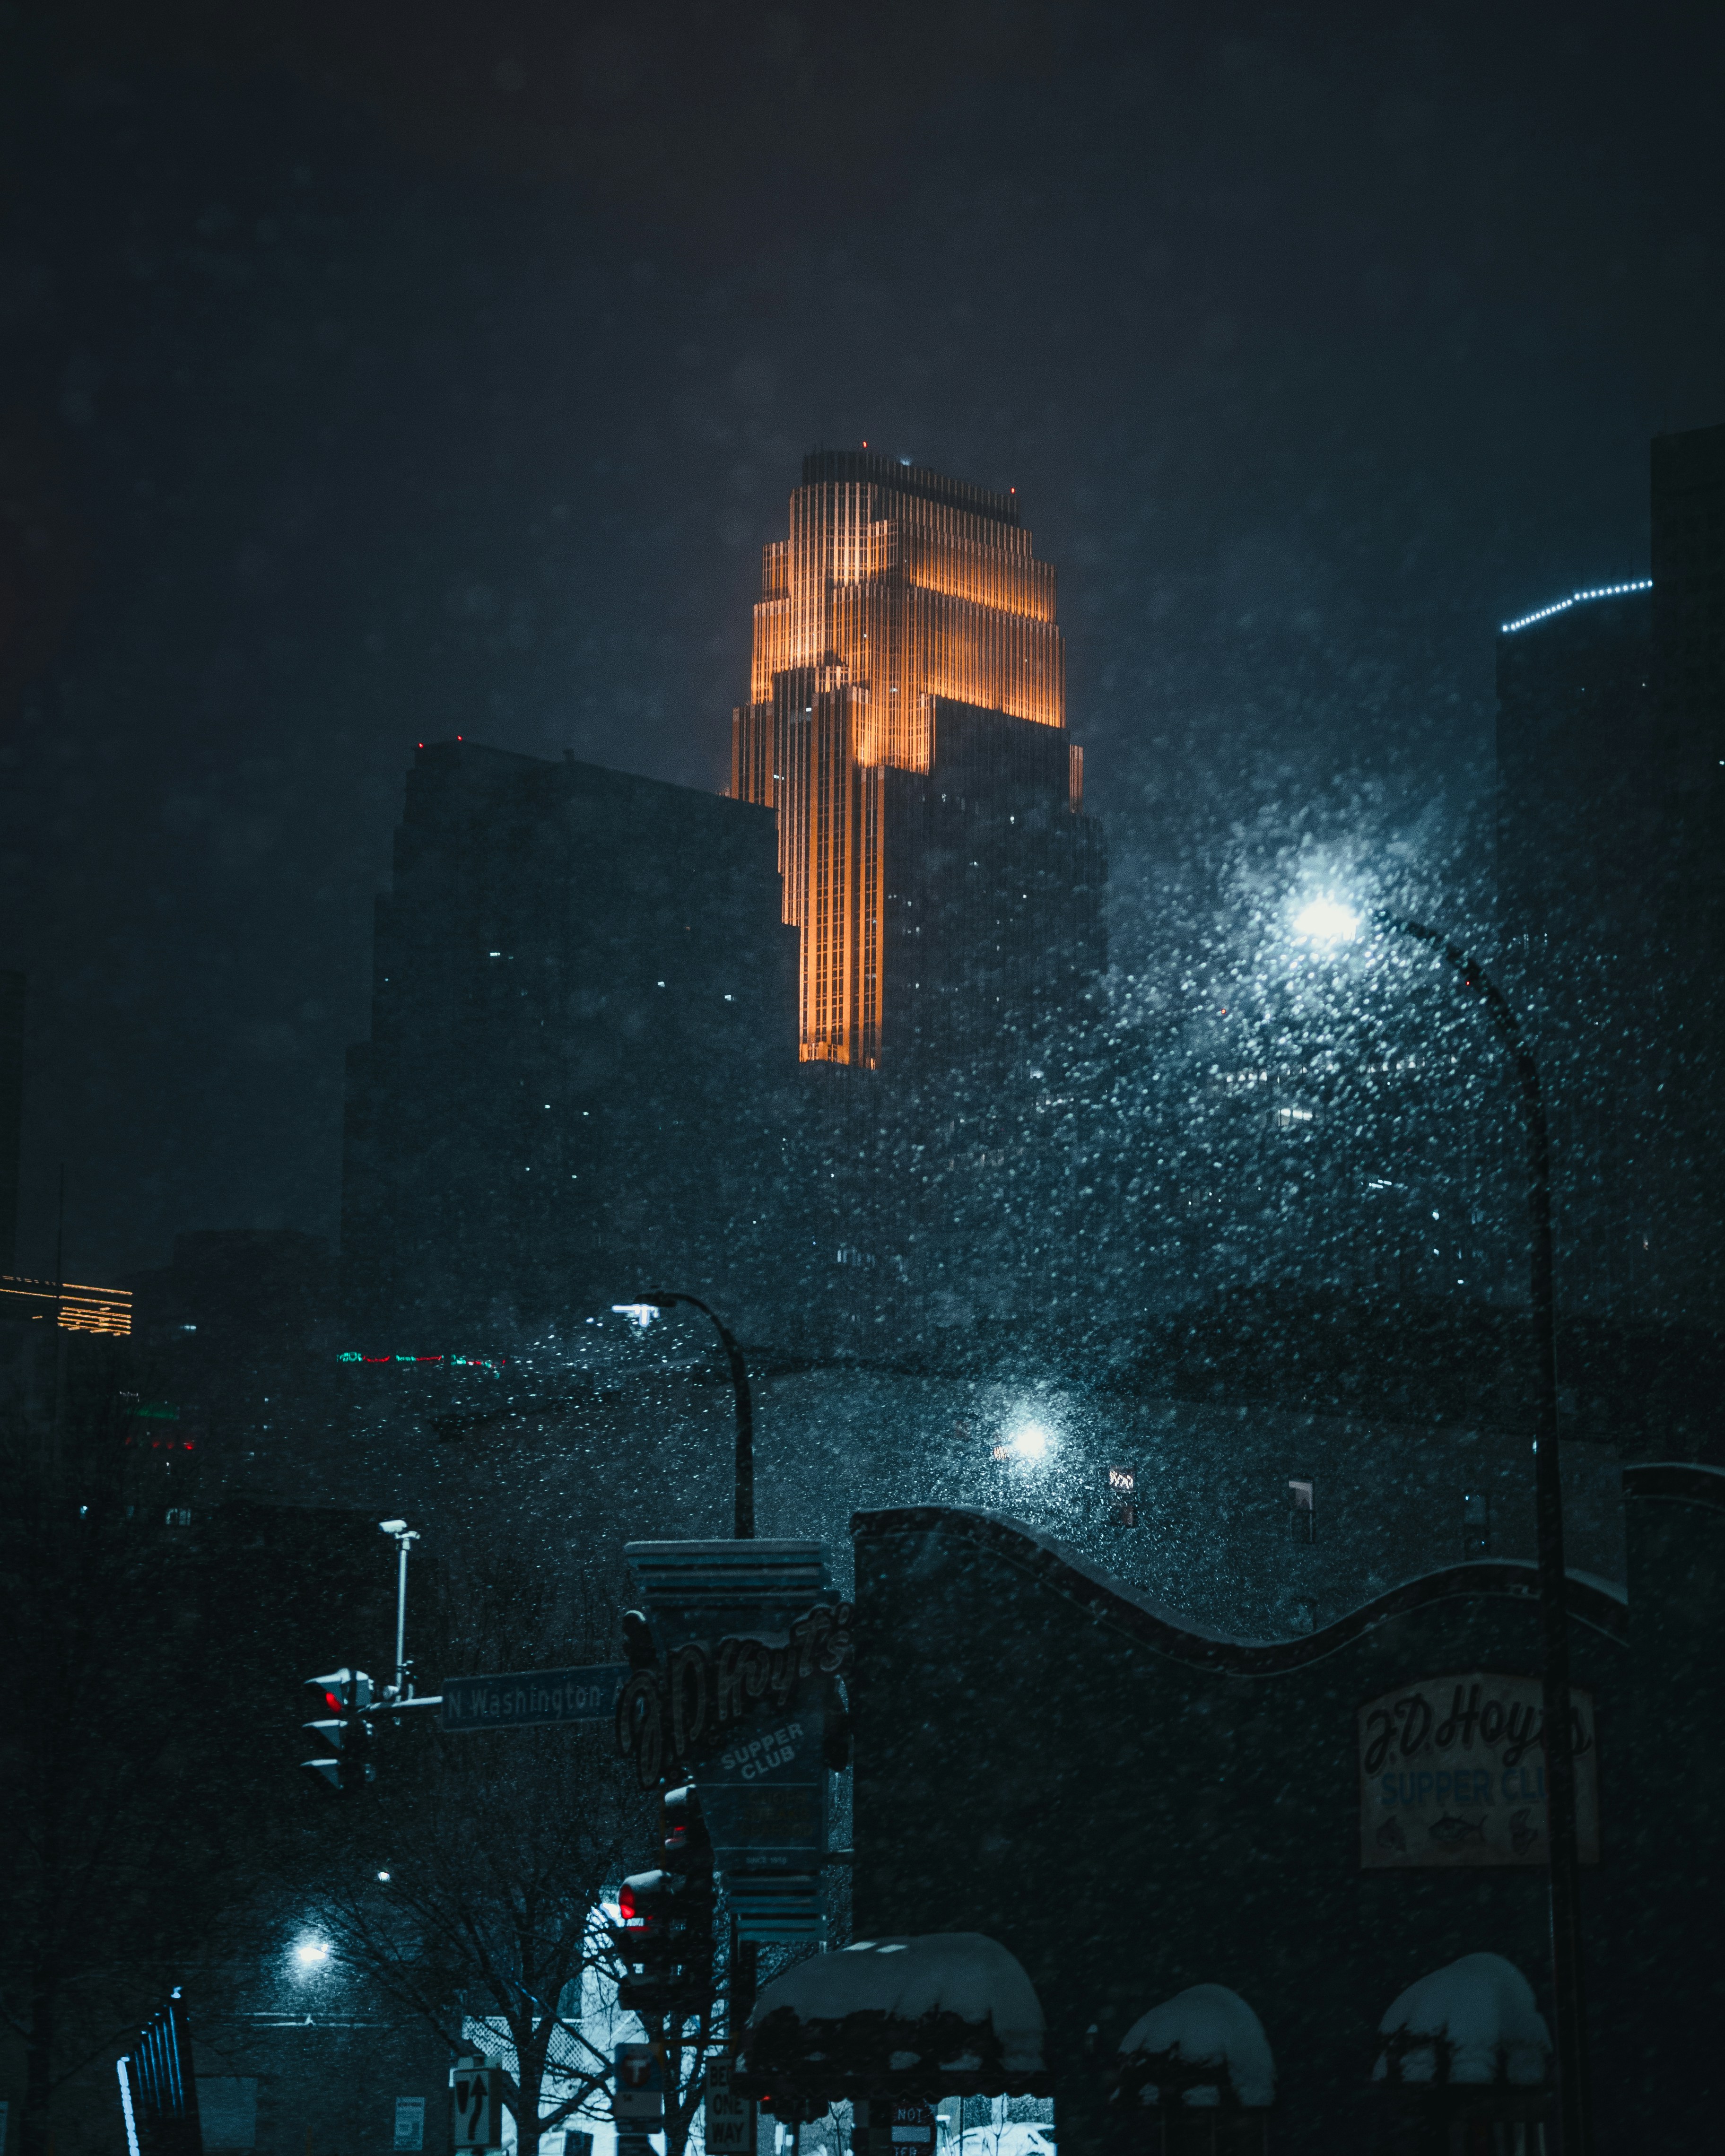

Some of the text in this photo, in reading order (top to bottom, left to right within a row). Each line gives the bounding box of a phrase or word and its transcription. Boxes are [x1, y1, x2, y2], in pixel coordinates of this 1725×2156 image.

[717, 1604, 852, 1721] Hoyt's
[448, 1690, 462, 1719] N
[471, 1682, 601, 1720] Washington
[721, 1722, 804, 1770] SUPPER
[1365, 1693, 1432, 1774] J.D.
[741, 1745, 795, 1778] CLUB
[749, 1791, 807, 1804] CHOPS
[1381, 1769, 1492, 1806] SUPPER
[744, 1807, 810, 1821] STEAKS
[741, 1823, 813, 1836] SEAFOOD
[713, 2094, 744, 2115] ONE
[897, 2107, 923, 2122] NOT
[712, 2122, 744, 2144] WAY
